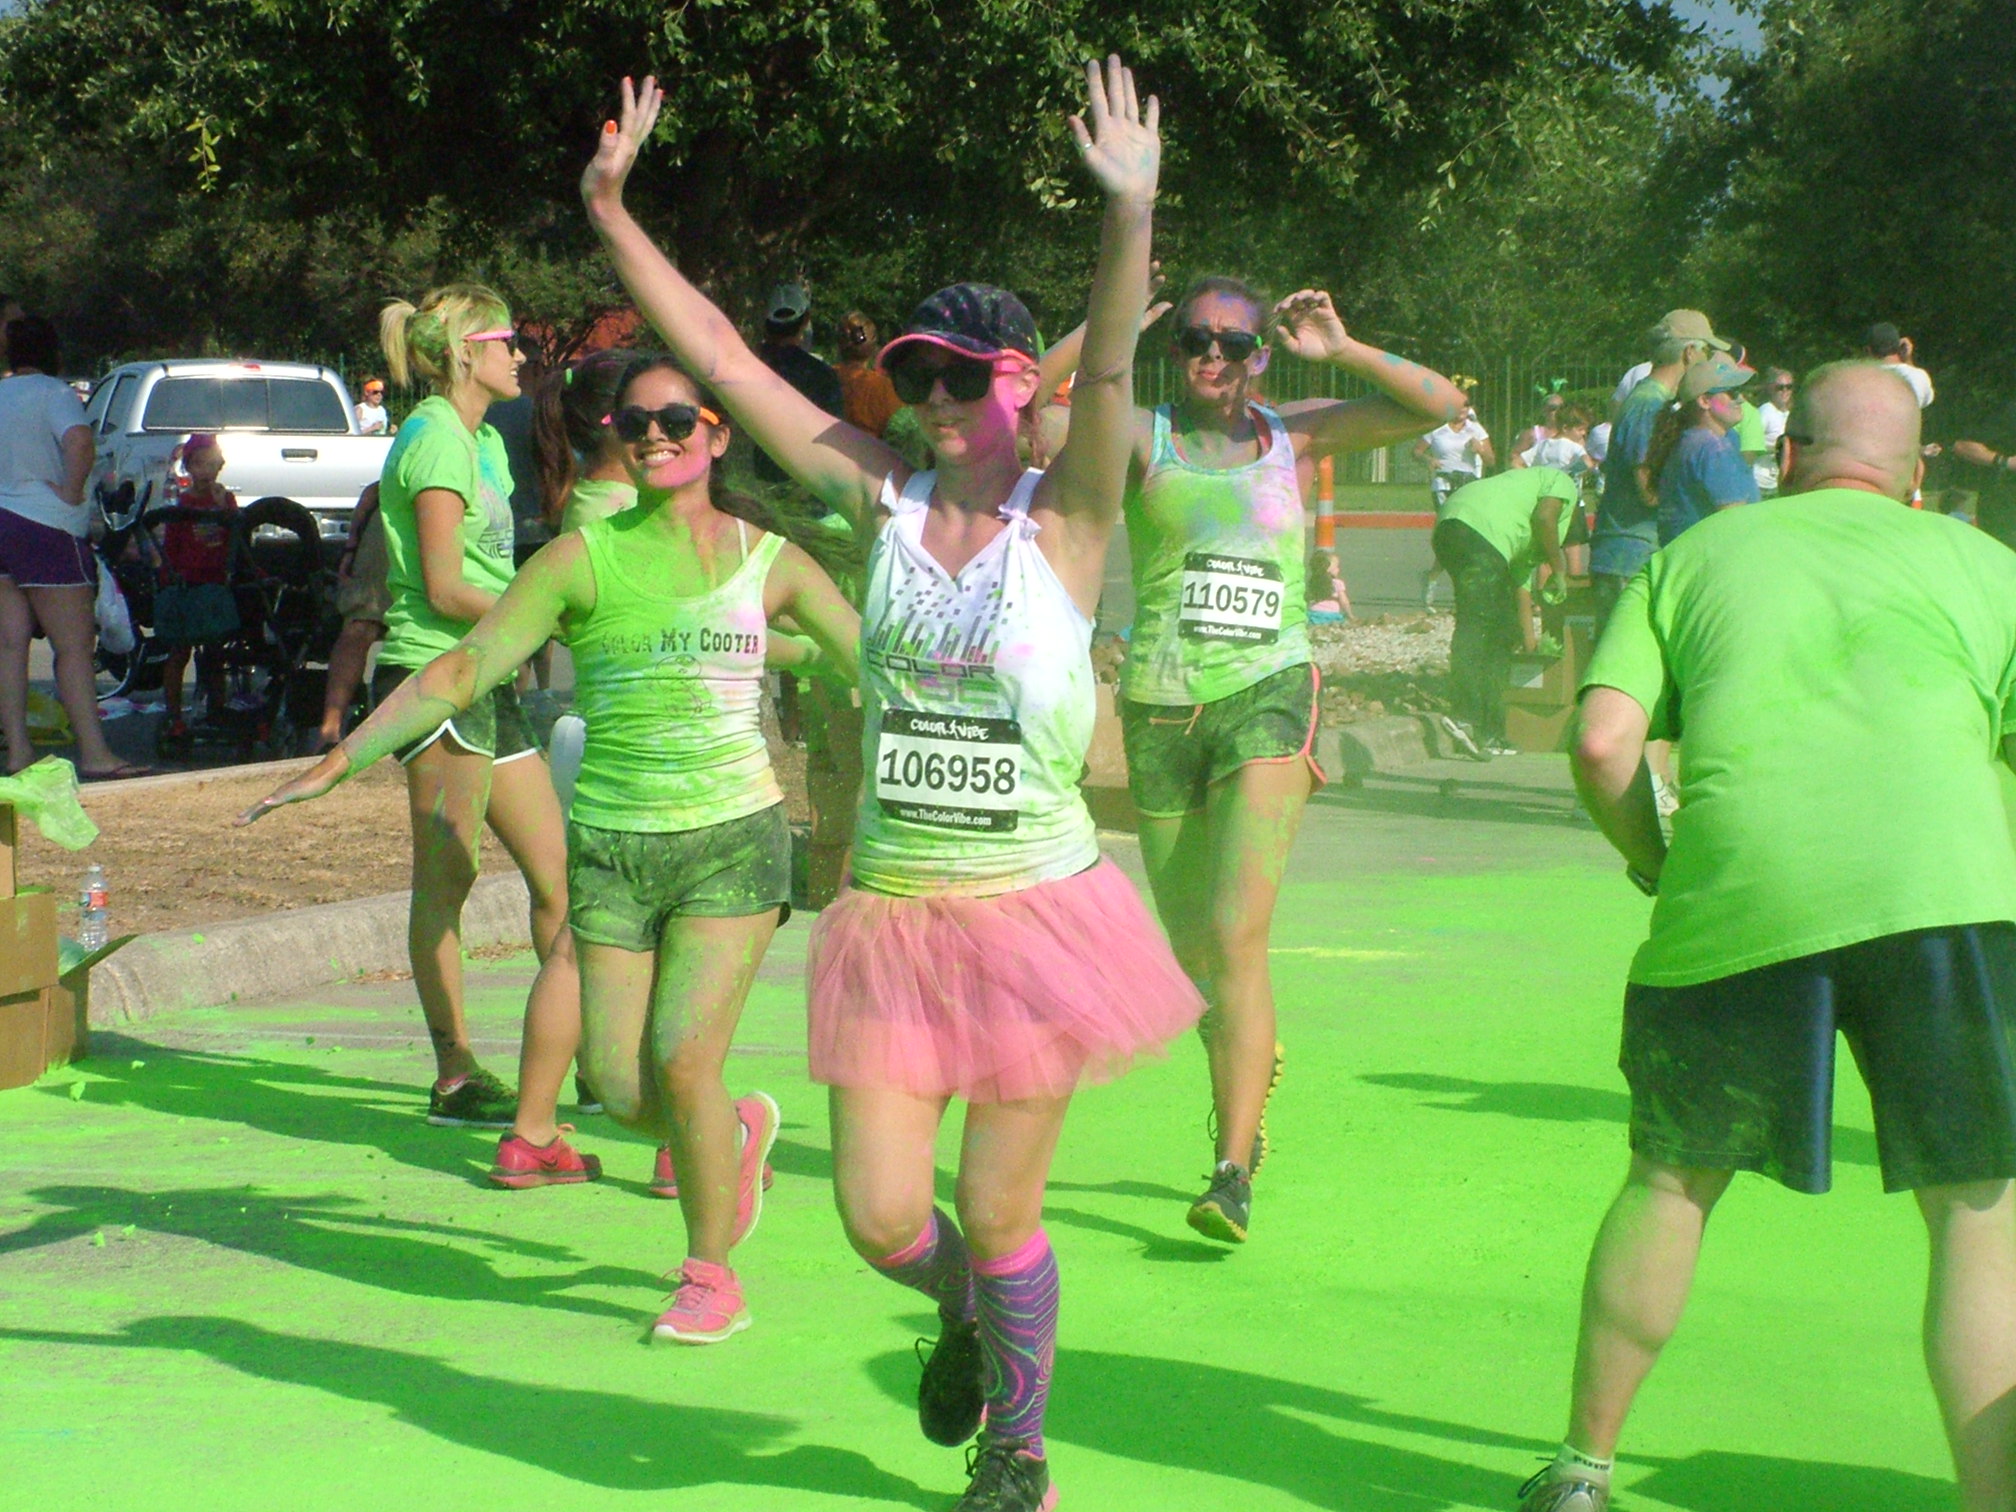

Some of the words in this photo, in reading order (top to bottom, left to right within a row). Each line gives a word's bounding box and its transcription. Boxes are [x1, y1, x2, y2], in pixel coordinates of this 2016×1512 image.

[1183, 581, 1280, 617] 110579
[867, 650, 996, 681] COLOR
[879, 748, 1016, 796] 106958
[899, 807, 993, 826] www.TheColorVibe.com
